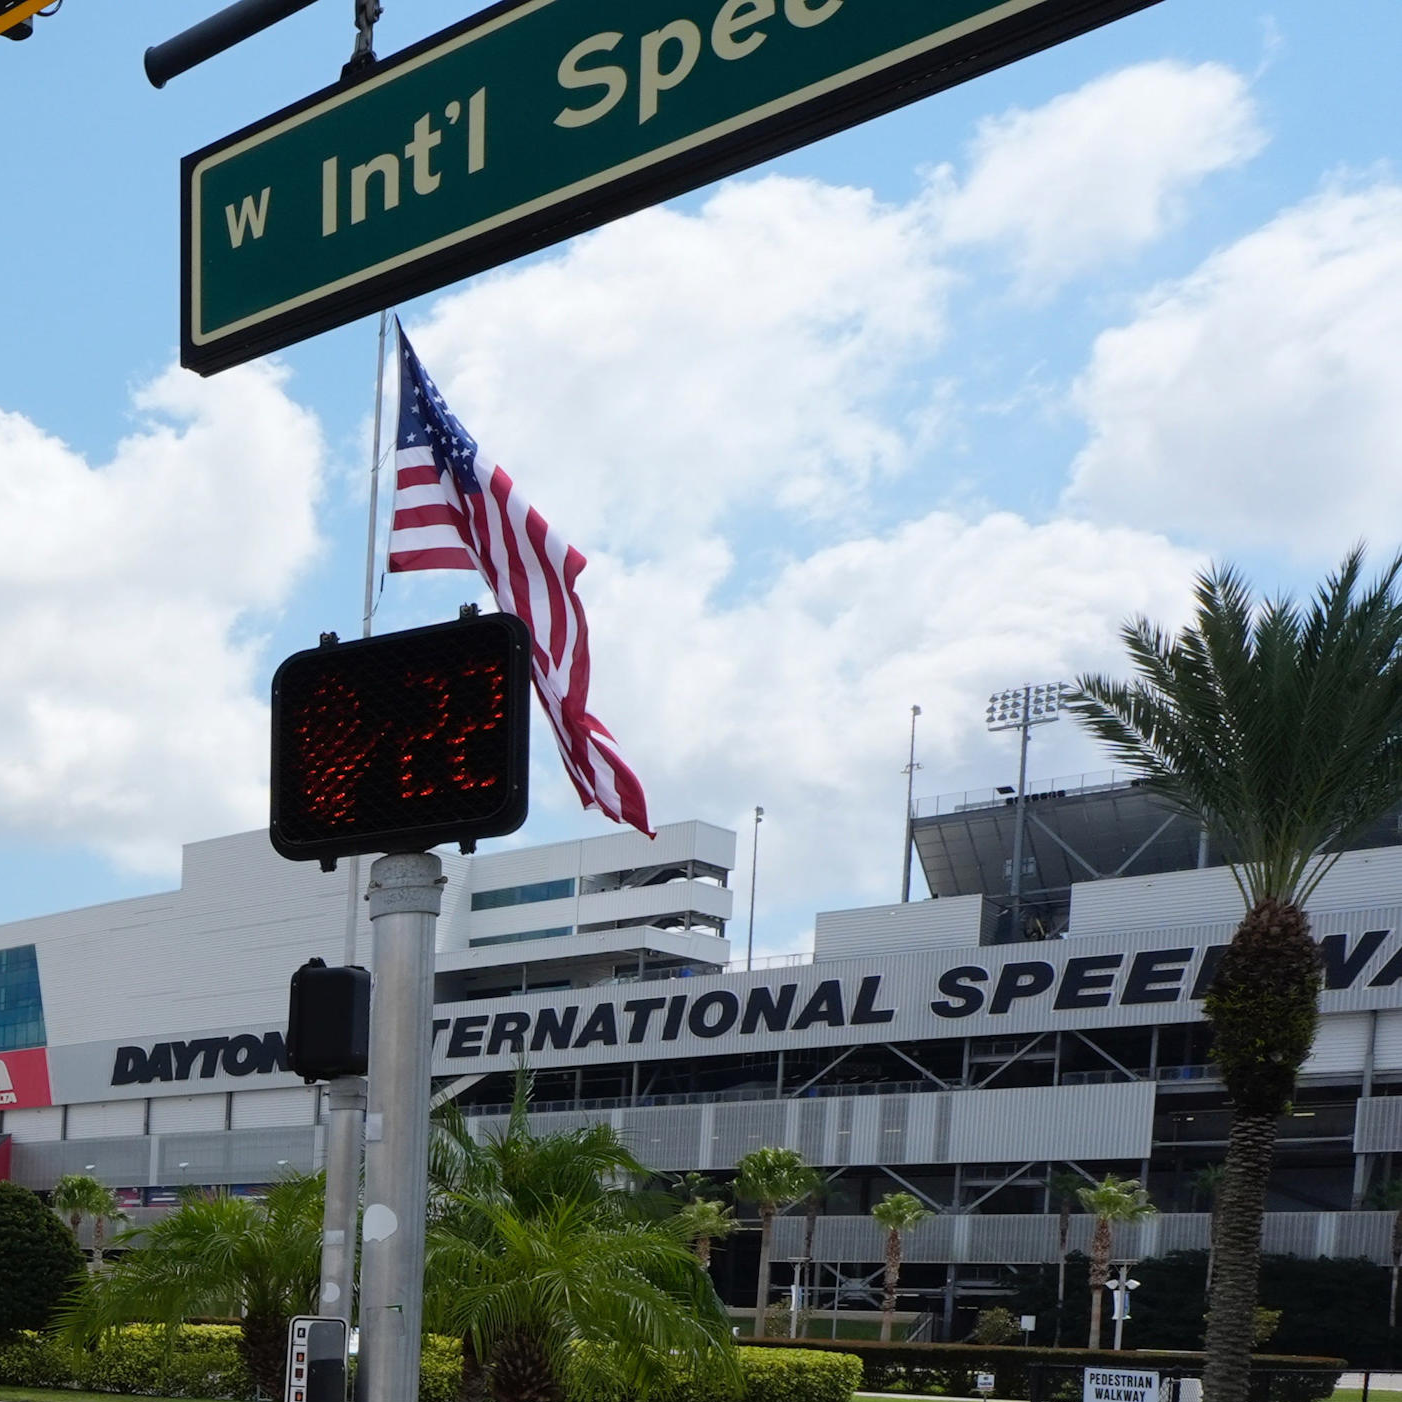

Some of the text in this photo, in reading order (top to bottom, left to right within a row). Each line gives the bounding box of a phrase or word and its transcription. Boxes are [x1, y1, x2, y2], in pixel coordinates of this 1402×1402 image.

[225, 187, 270, 248] W
[321, 87, 486, 237] Int'l
[110, 1031, 295, 1085] DAYTON
[433, 976, 895, 1058] ERNATIONAL
[1089, 1373, 1153, 1389] PEDESTRIAN
[1095, 1388, 1146, 1402] WALKWAY
